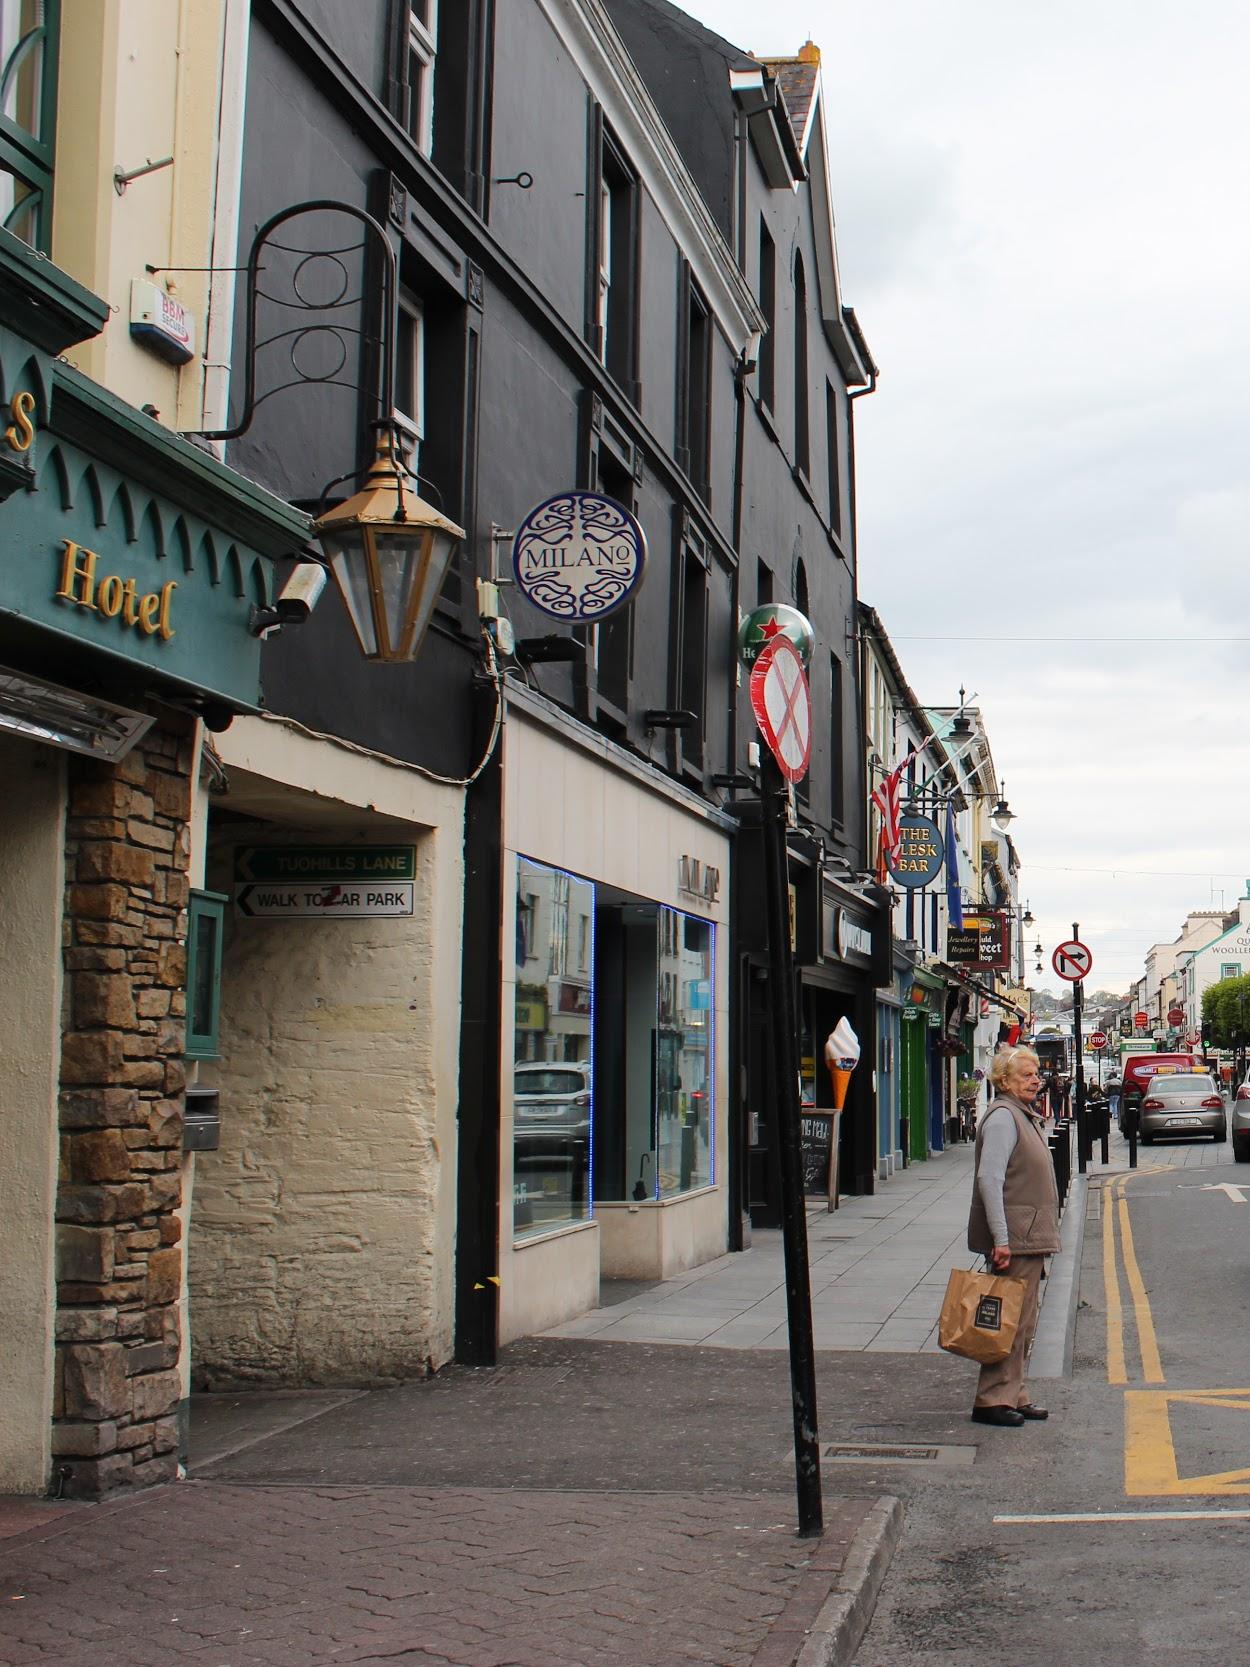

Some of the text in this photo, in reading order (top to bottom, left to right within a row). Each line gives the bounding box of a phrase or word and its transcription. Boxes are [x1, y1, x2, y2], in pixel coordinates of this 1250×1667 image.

[525, 545, 631, 569] MILANO
[56, 538, 179, 641] Hotel
[900, 828, 930, 841] THE
[900, 843, 937, 857] LESK
[363, 856, 407, 870] LANE
[899, 859, 929, 872] BAR
[257, 893, 405, 907] WALK TO AR PARK
[948, 935, 978, 944] Jewellery
[980, 954, 993, 962] hop
[1091, 1036, 1106, 1044] STOP
